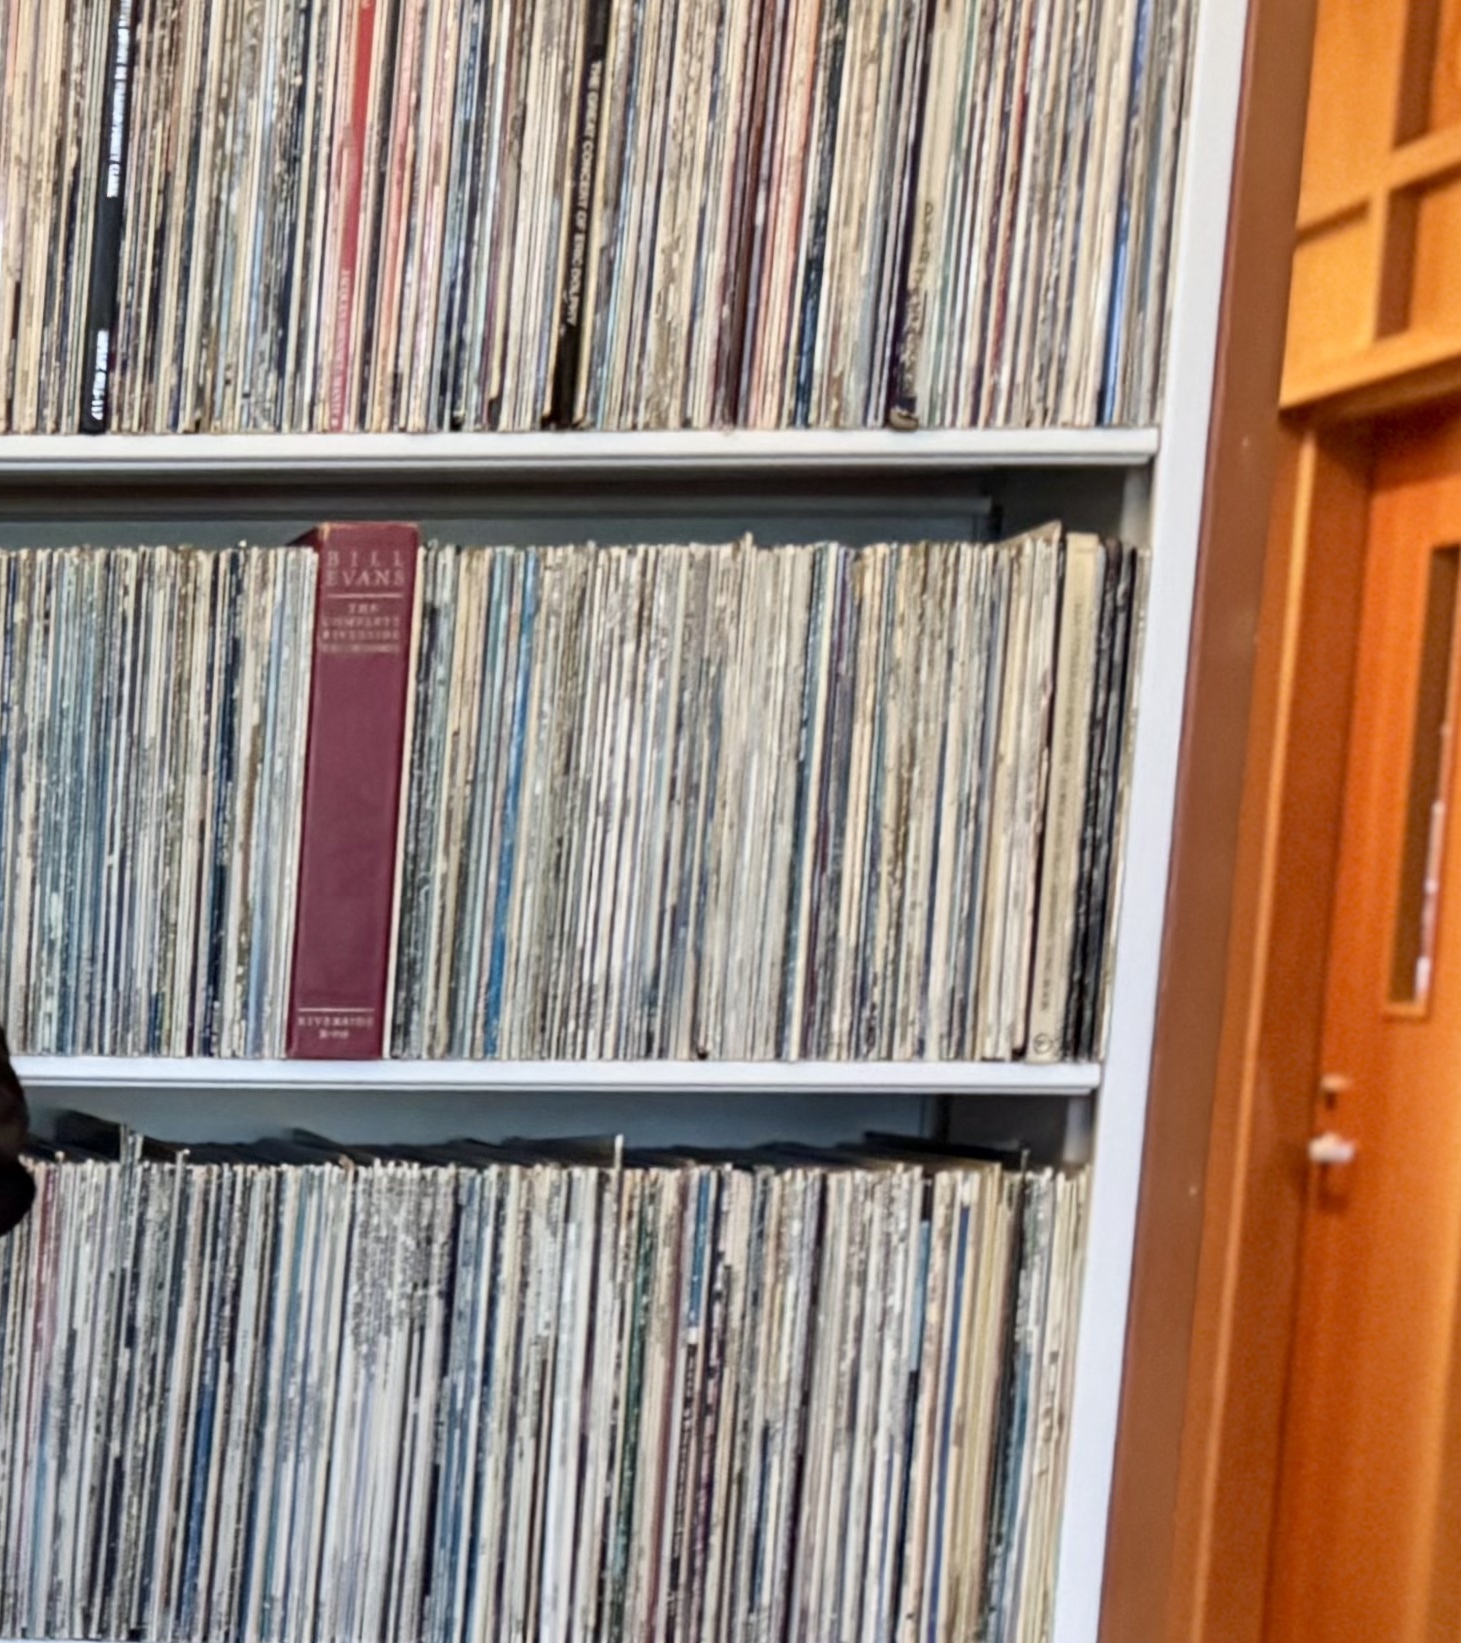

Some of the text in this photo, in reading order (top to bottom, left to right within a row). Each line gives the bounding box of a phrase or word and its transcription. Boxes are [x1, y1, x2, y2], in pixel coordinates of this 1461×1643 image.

[567, 60, 602, 327] THE GREAT CONCERT OF ERIC DOLPHY
[326, 549, 404, 568] BILL
[325, 568, 405, 587] EVANS
